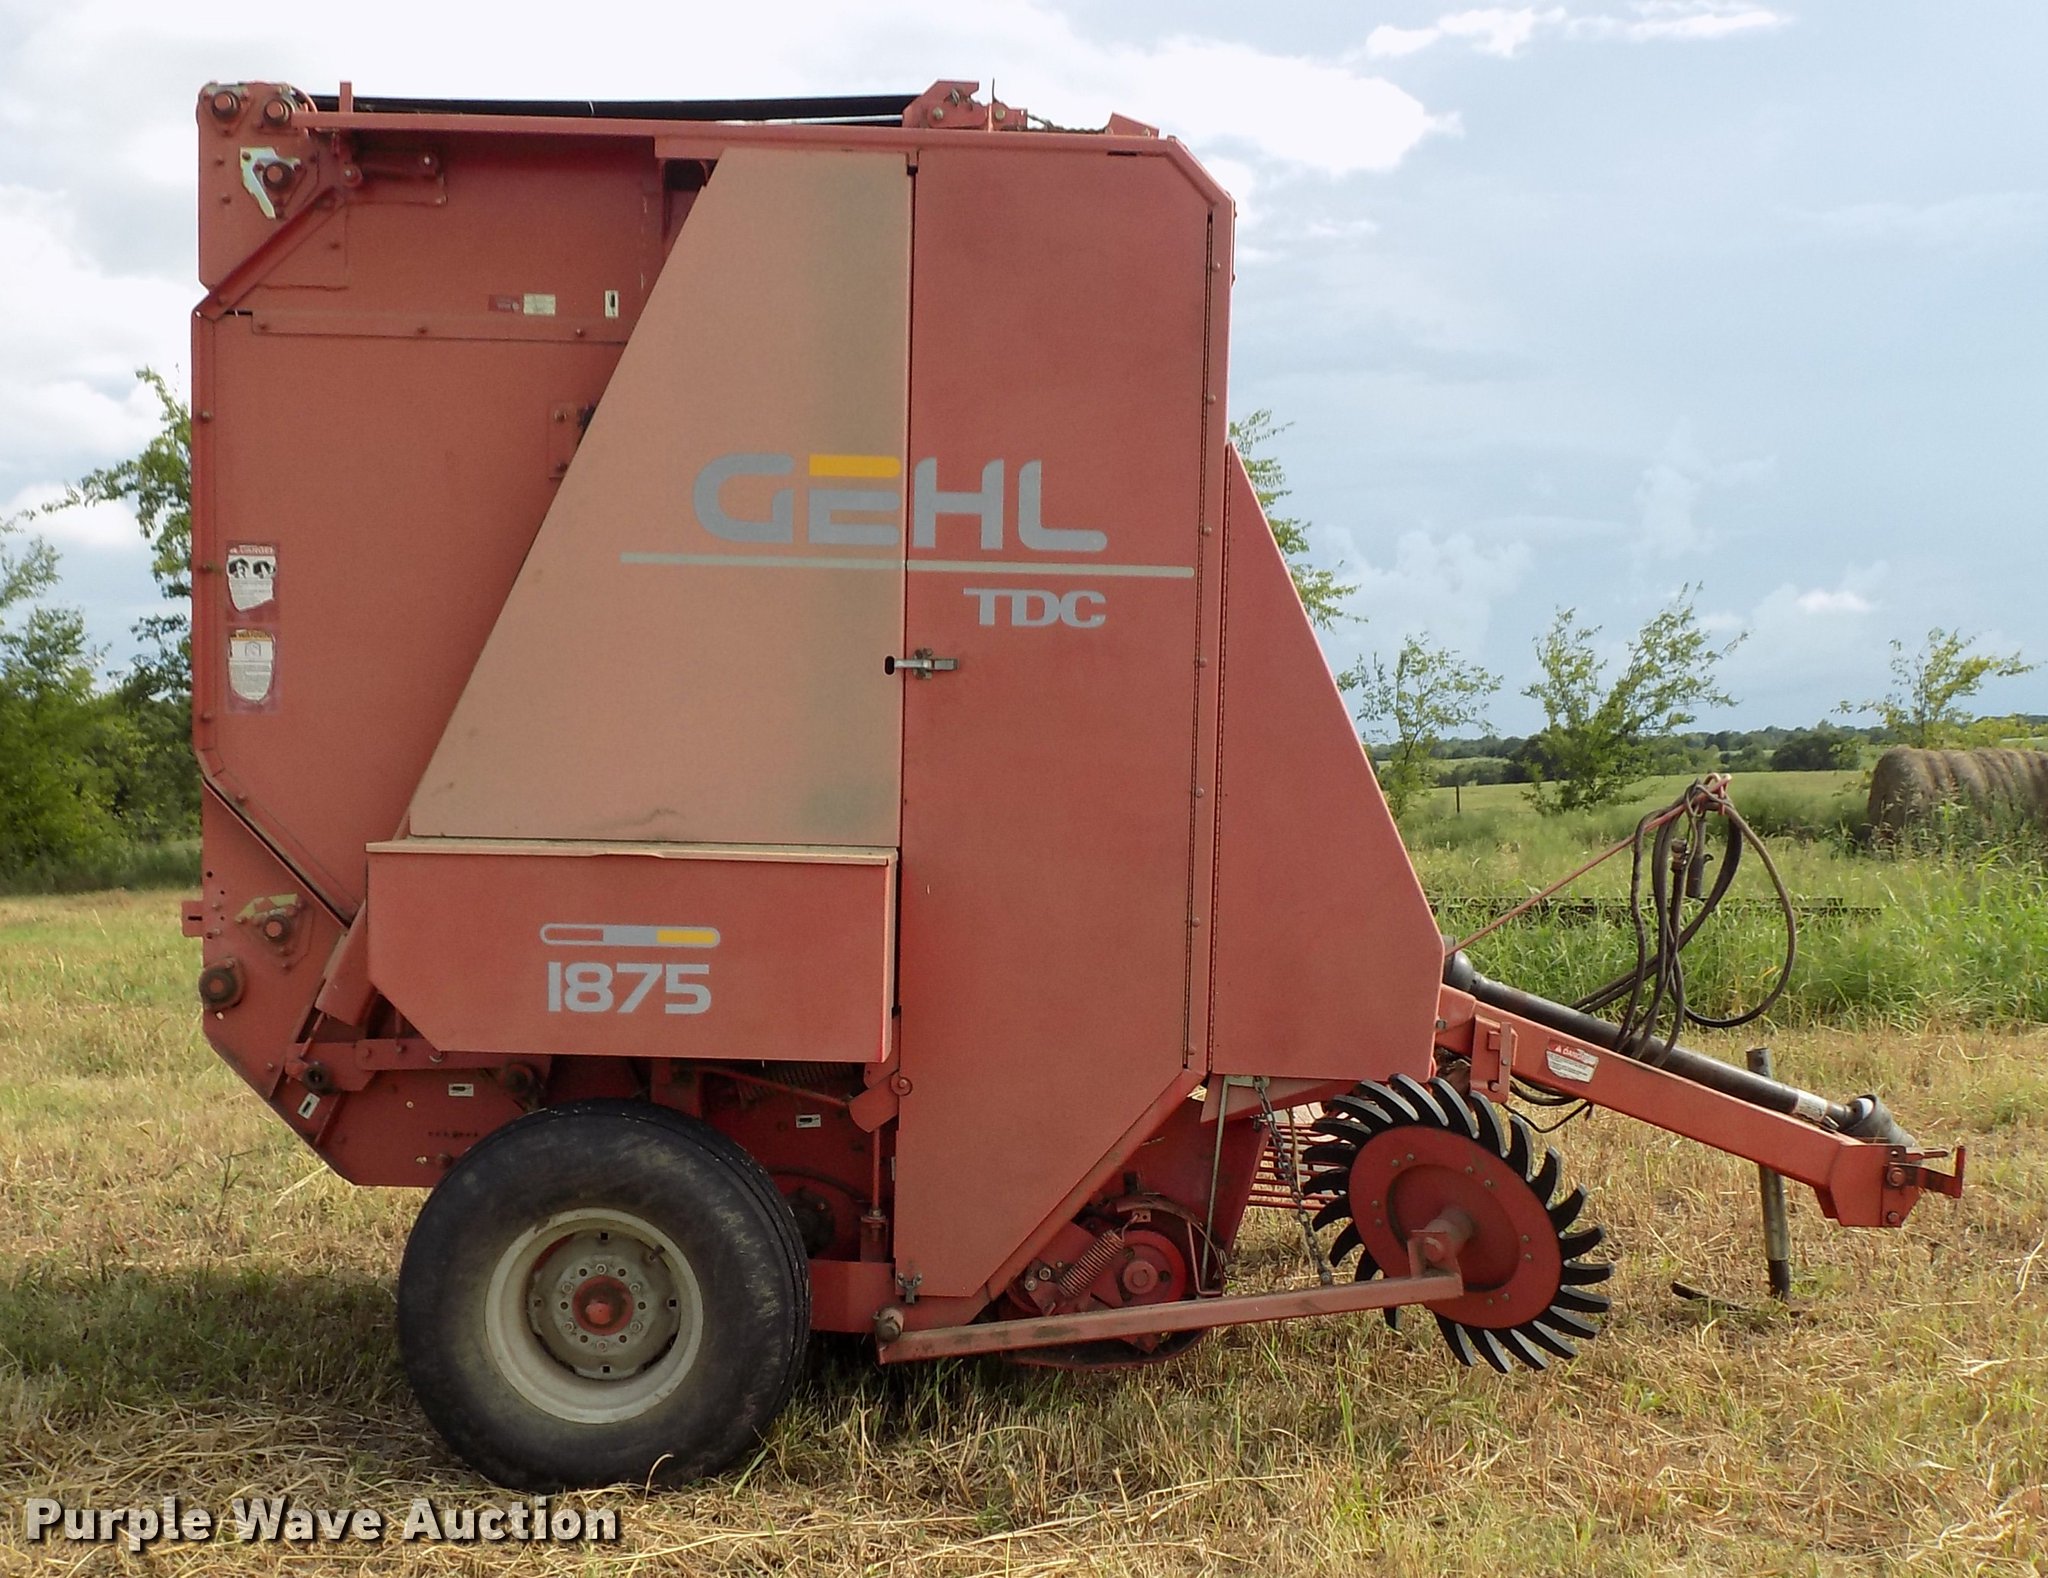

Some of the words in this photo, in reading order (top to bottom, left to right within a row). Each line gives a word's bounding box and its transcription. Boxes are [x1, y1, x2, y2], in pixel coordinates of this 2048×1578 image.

[692, 453, 1108, 553] GEHL
[963, 587, 1107, 629] TDC
[547, 961, 712, 1015] 1875
